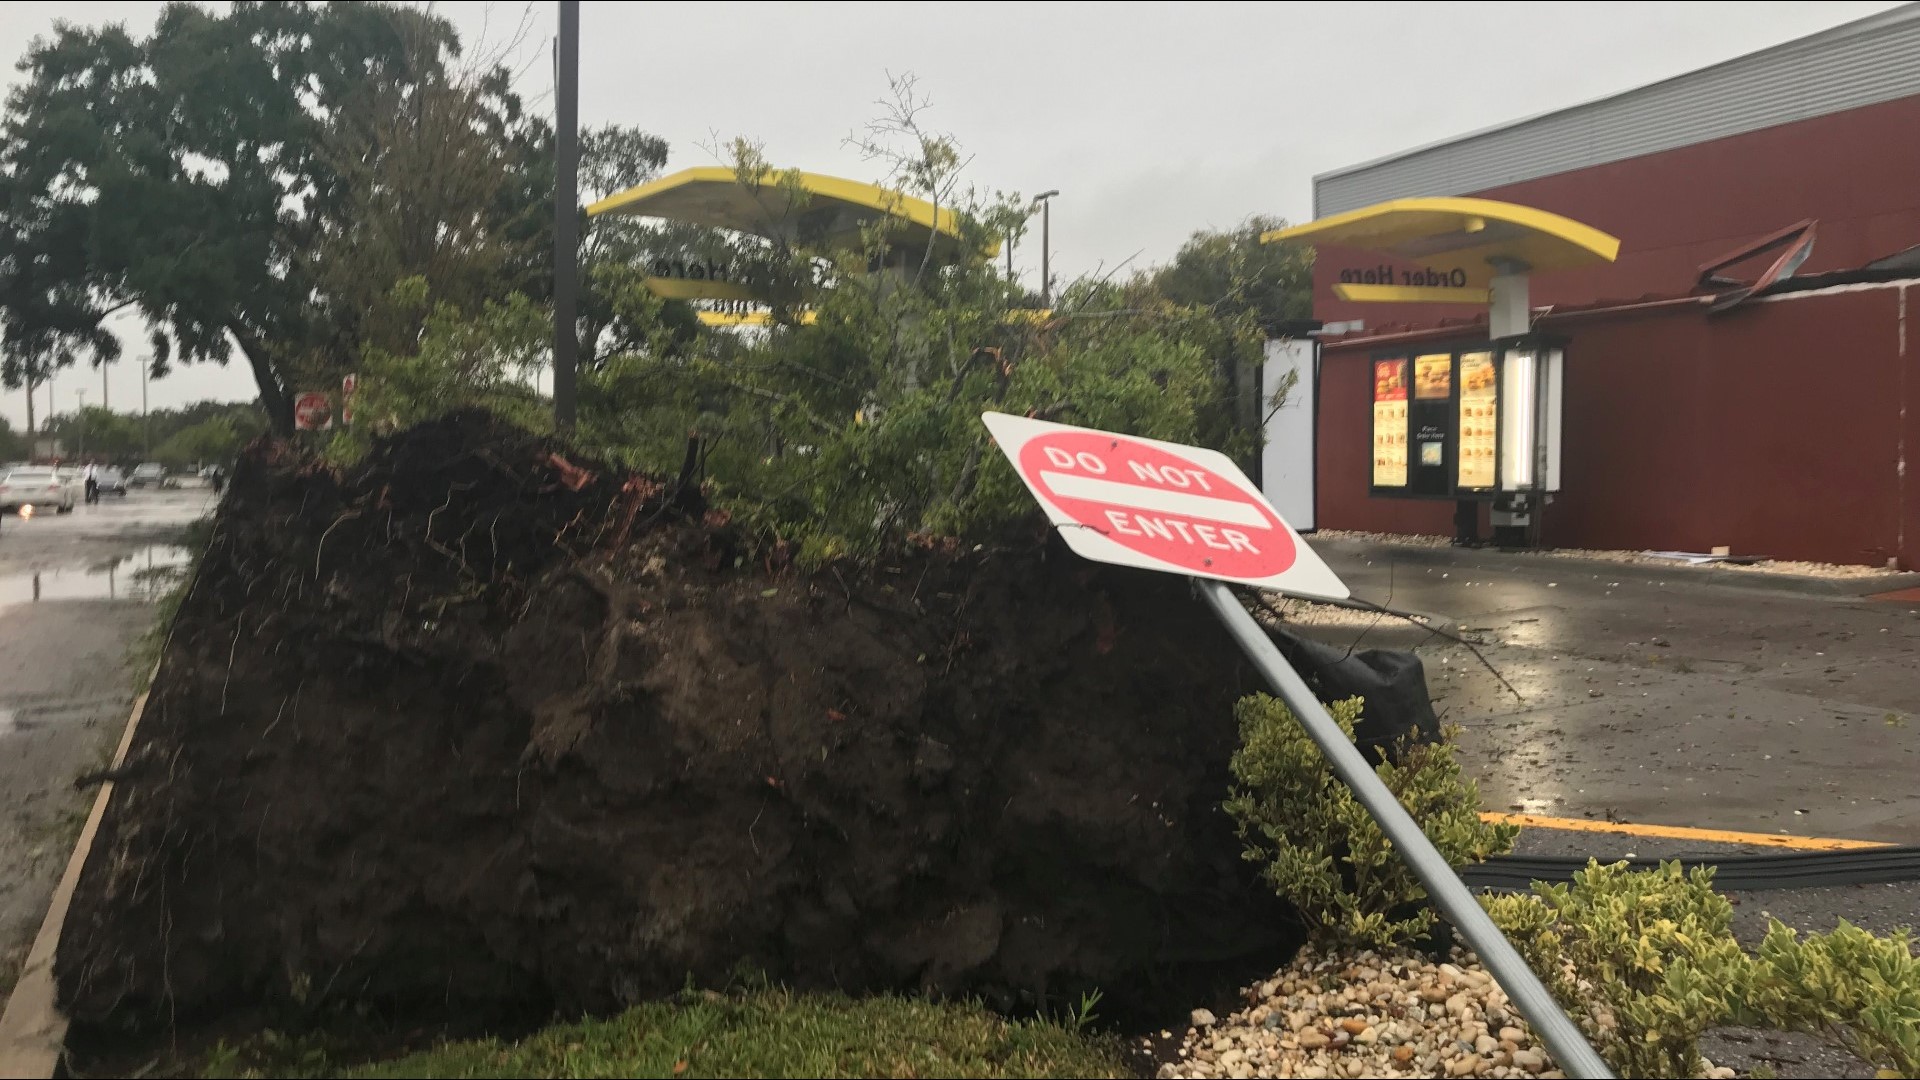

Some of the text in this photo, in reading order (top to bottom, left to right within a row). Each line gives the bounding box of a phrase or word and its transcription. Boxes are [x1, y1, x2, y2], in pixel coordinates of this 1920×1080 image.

[1043, 446, 1213, 492] DO NOT
[1104, 509, 1262, 556] ENTER
